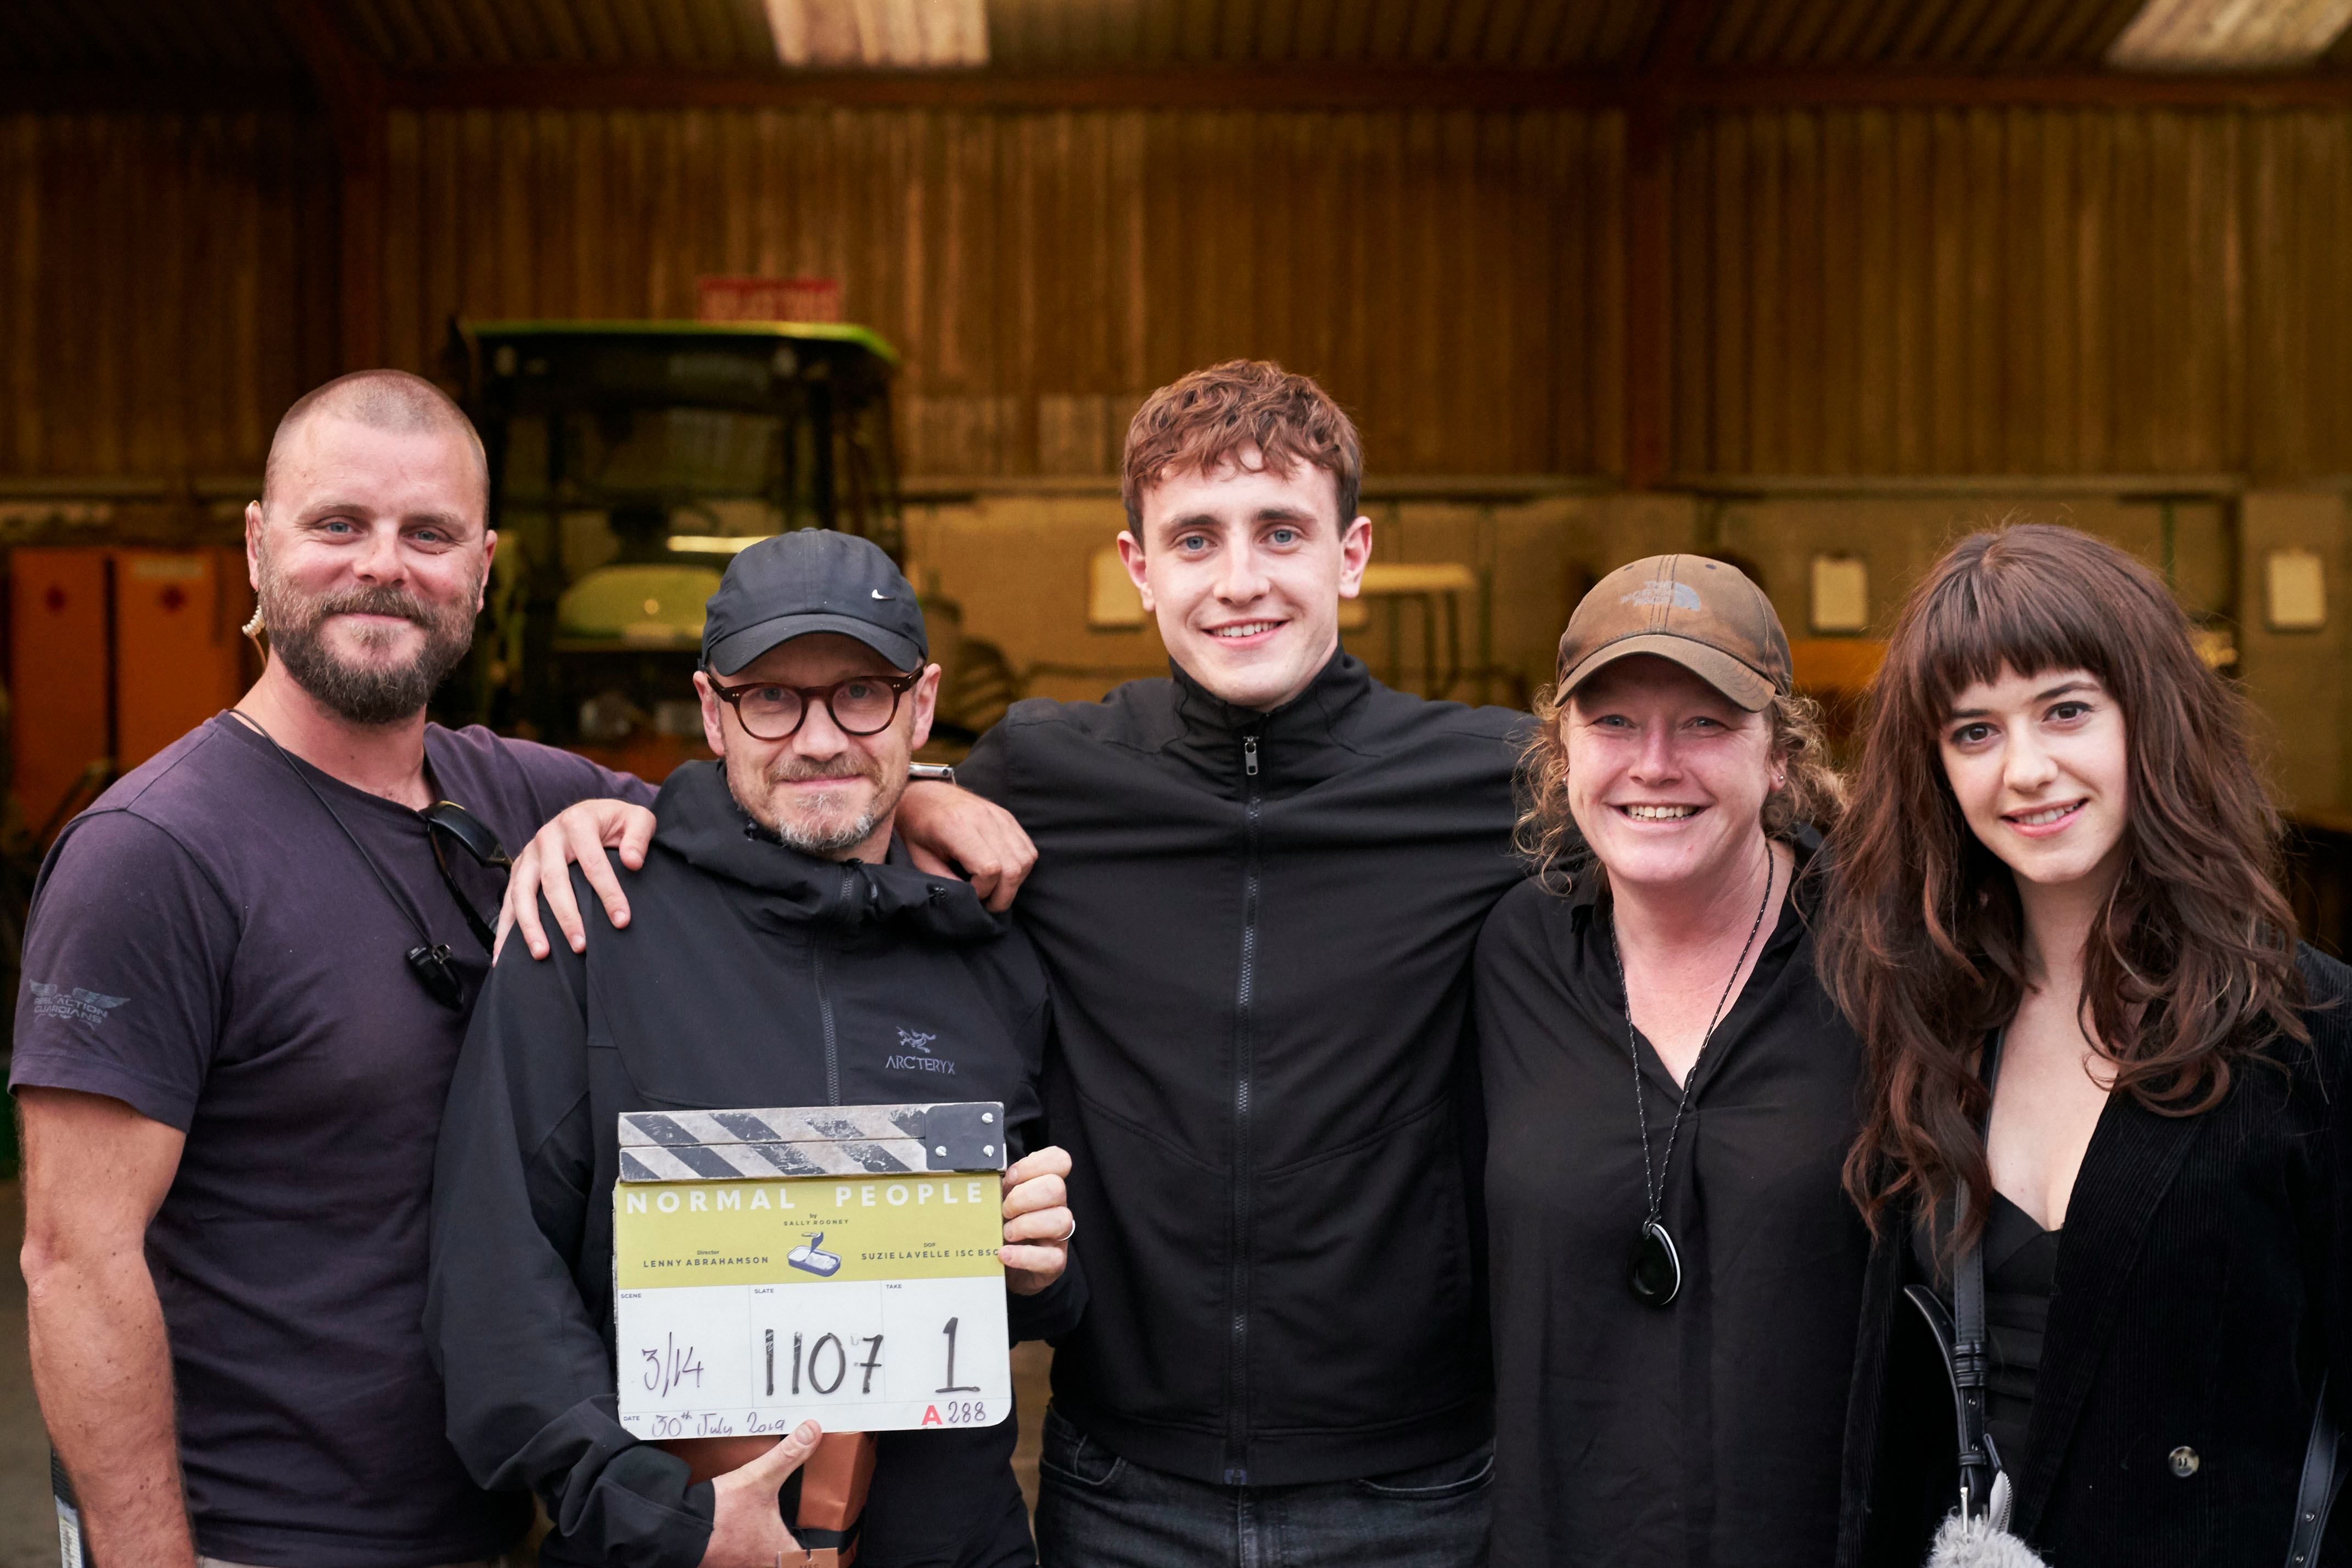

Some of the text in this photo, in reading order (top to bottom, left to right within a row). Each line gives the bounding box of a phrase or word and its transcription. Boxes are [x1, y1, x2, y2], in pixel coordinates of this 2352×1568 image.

[34, 1005, 103, 1024] GUARDIANS
[57, 997, 108, 1018] ACTION
[626, 1182, 982, 1214] NORMAL PEOPLE
[643, 1256, 769, 1268] LENNY ABRAHAMSON
[899, 1250, 950, 1259] LAVELLE
[642, 1331, 704, 1397] 3/14
[765, 1328, 883, 1396] 1107
[935, 1317, 981, 1393] 1
[697, 1413, 733, 1437] July
[747, 1412, 785, 1433] 2019
[921, 1401, 986, 1426] A 288
